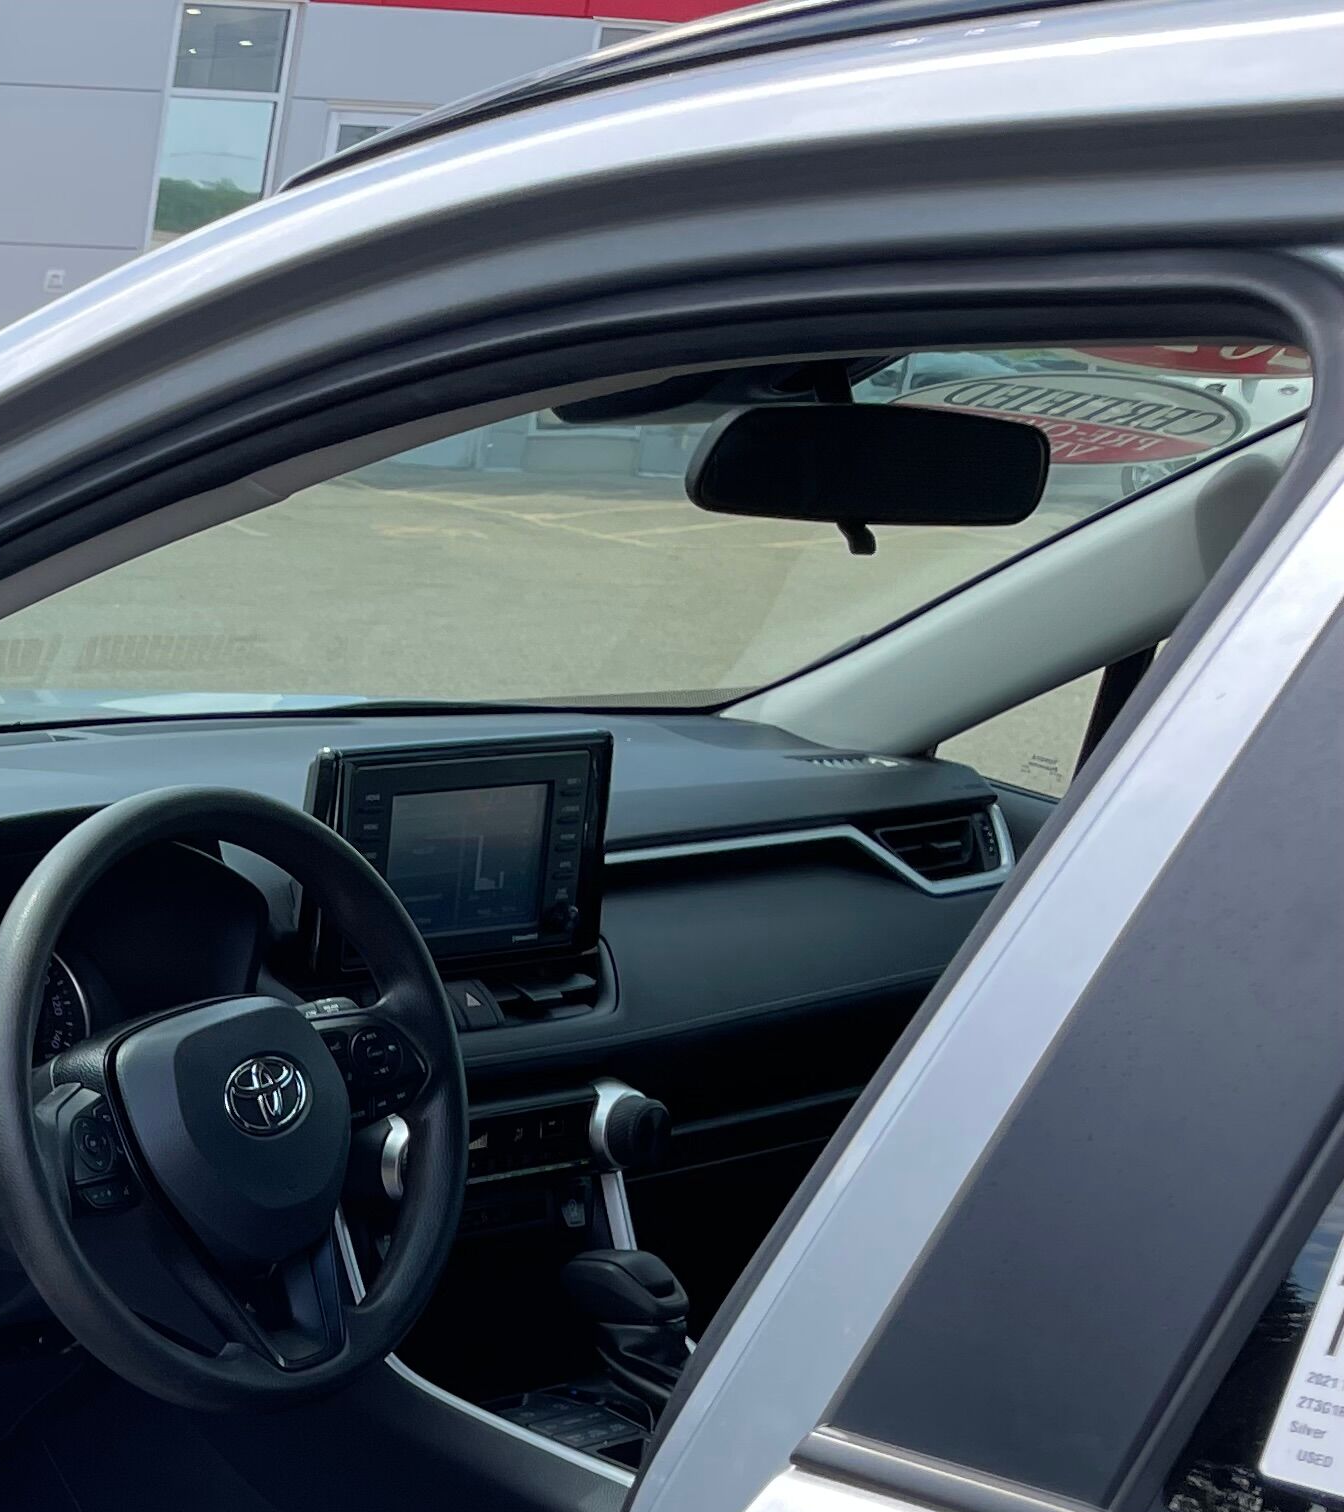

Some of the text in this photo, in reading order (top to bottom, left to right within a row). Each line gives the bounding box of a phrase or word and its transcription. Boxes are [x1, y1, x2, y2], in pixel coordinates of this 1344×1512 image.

[1307, 1371, 1338, 1390] 2021
[1289, 1420, 1327, 1440] Silver
[1296, 1449, 1333, 1469] USED
